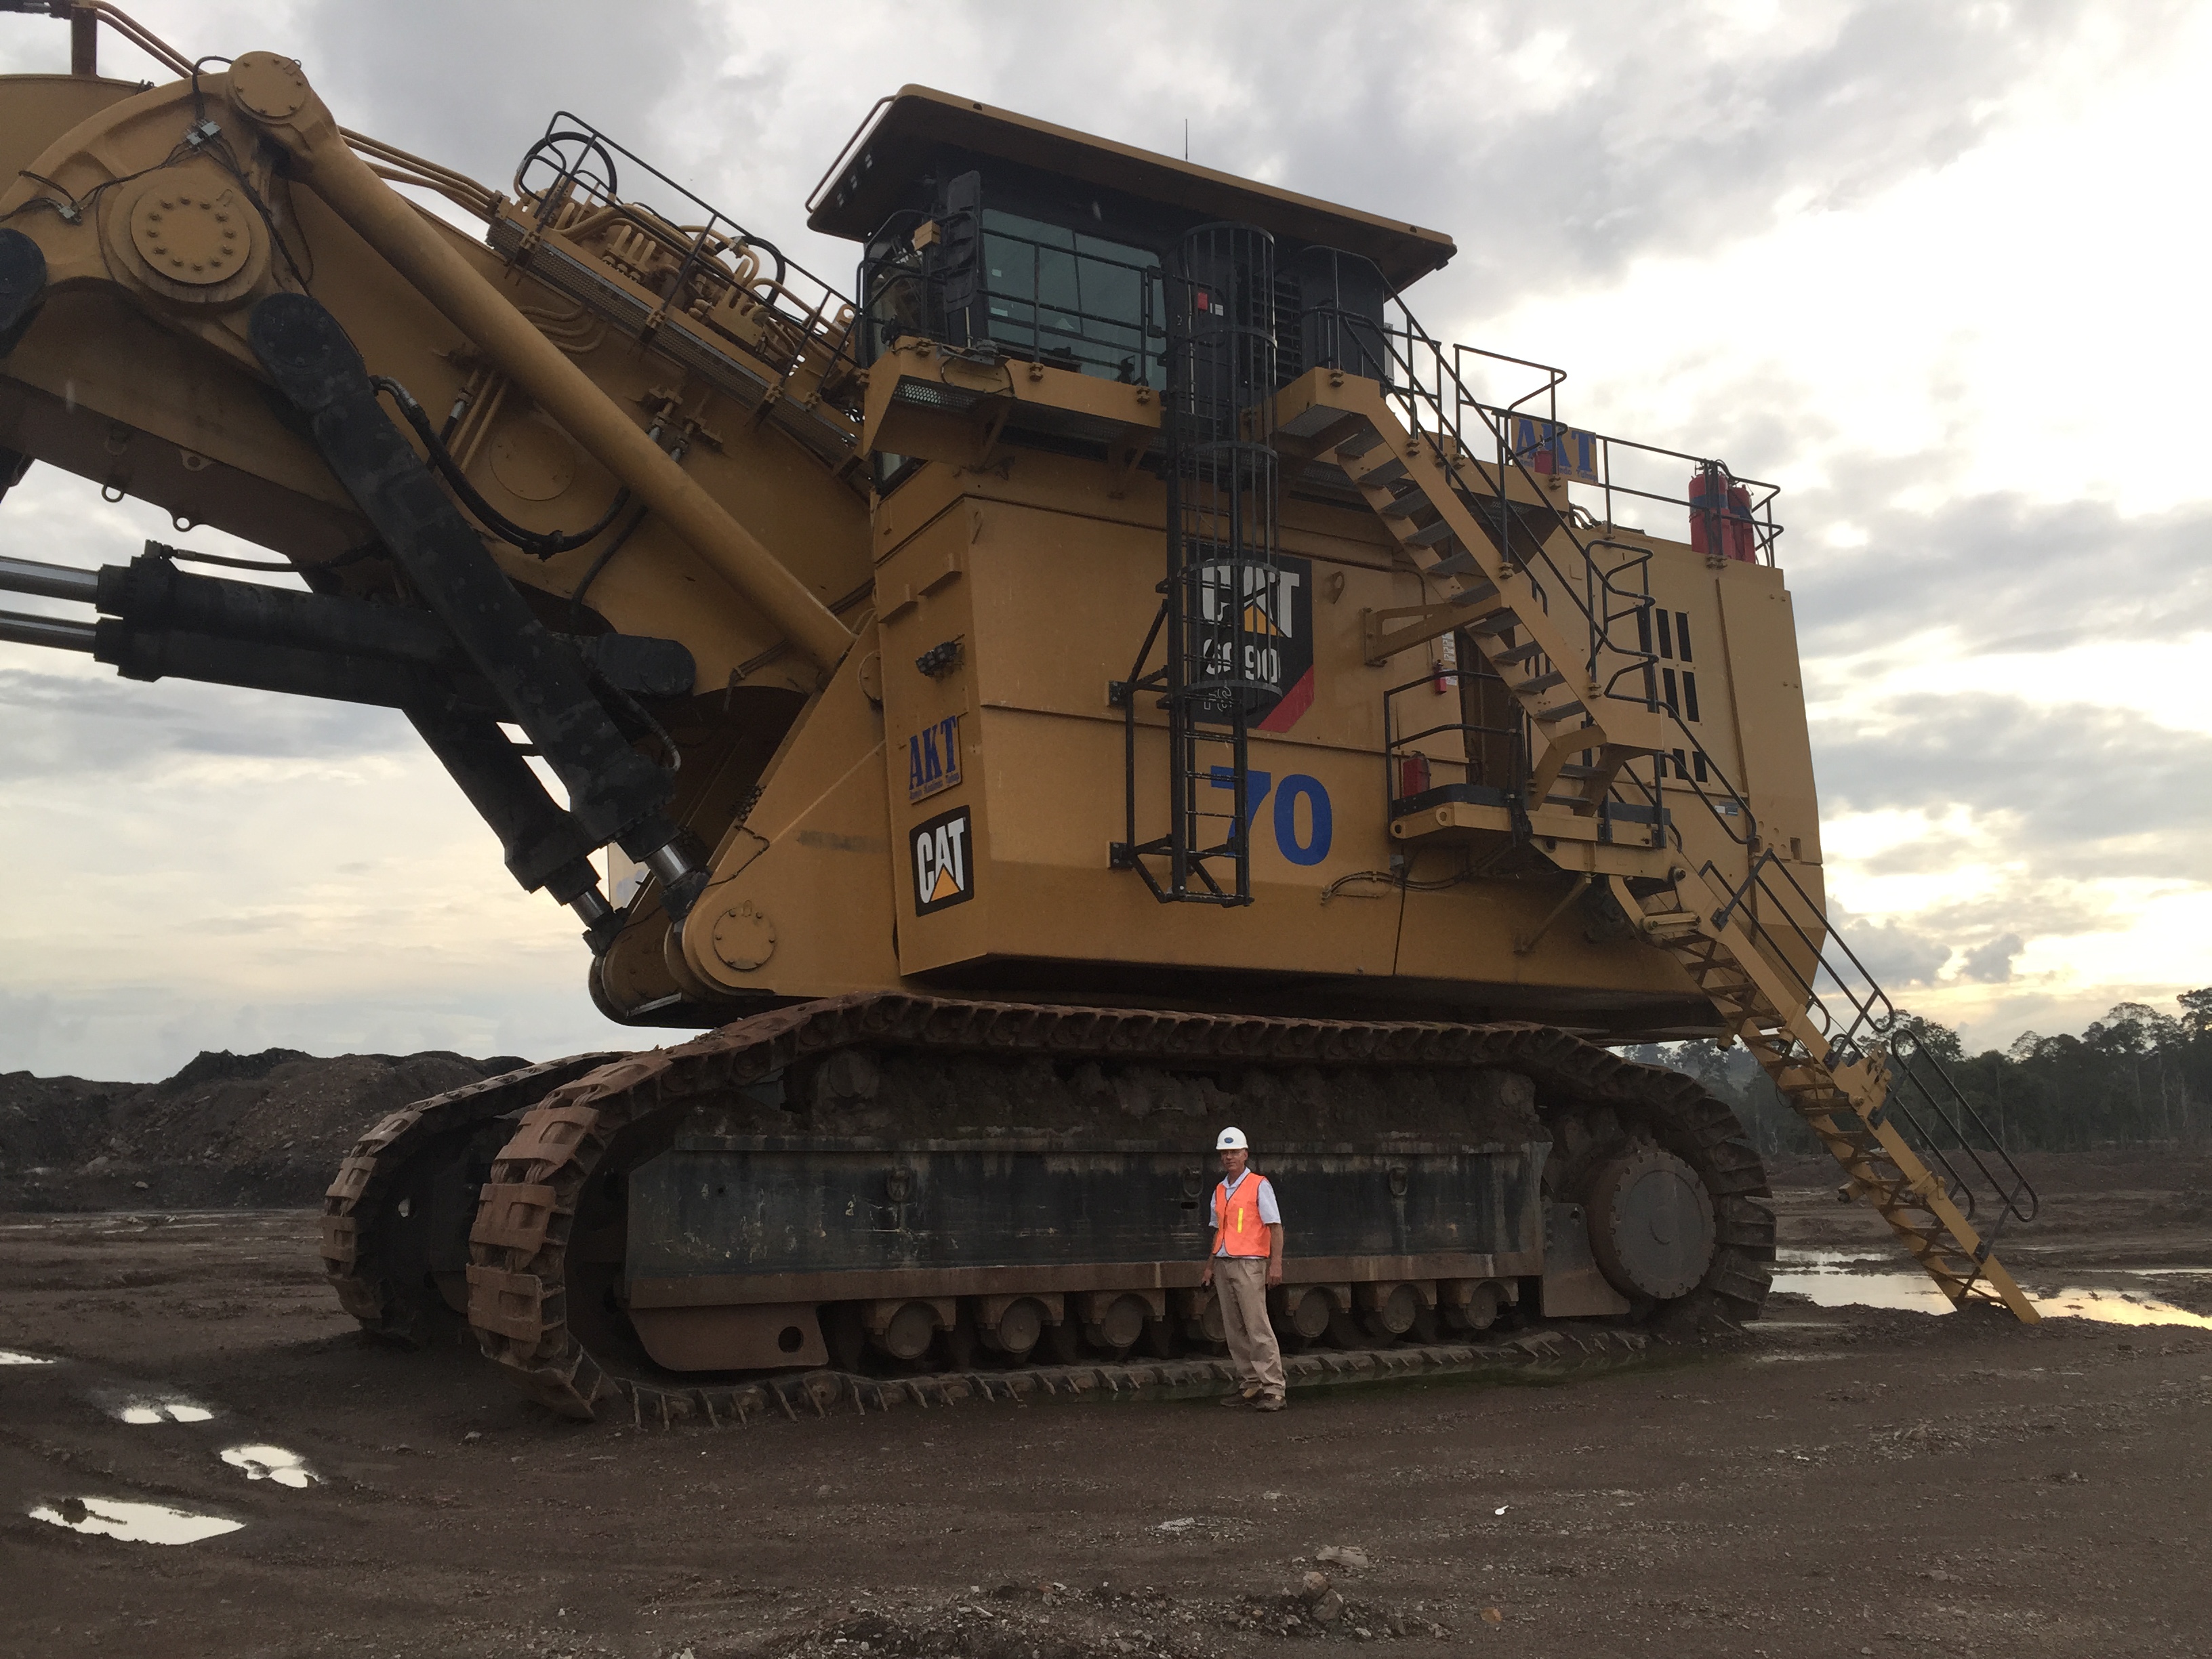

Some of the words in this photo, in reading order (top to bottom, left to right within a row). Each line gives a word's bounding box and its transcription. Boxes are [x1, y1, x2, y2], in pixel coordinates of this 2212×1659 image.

[1516, 418, 1596, 472] AKT
[1202, 558, 1300, 638] CAT
[909, 716, 957, 790] AKT
[1210, 765, 1333, 866] 70
[916, 817, 965, 903] CAT
